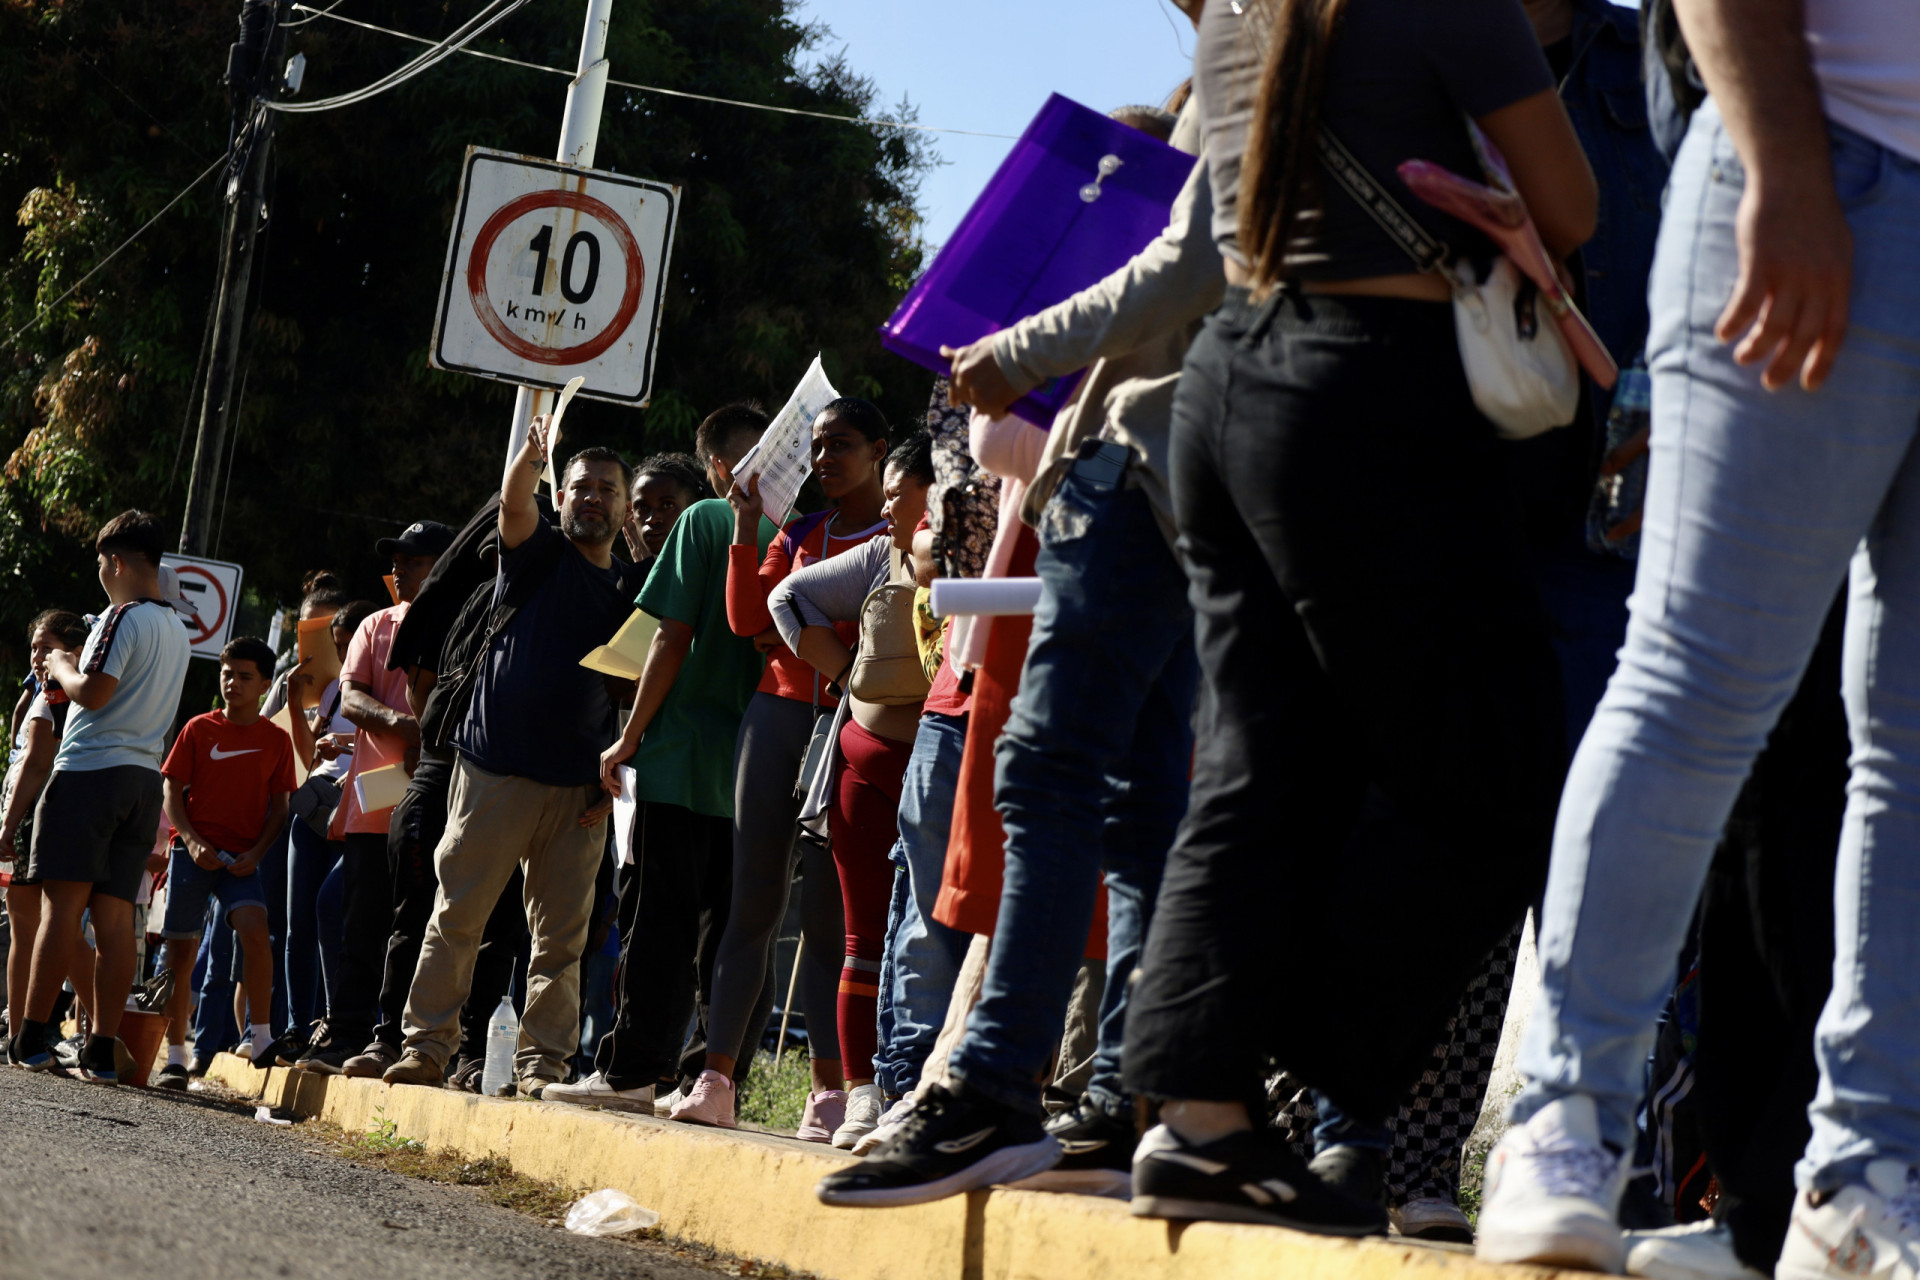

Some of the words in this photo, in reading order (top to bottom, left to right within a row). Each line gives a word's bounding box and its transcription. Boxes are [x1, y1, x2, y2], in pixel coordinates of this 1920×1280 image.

[1344, 167, 1375, 201] NOW
[529, 224, 601, 305] 10
[507, 300, 586, 330] km/h
